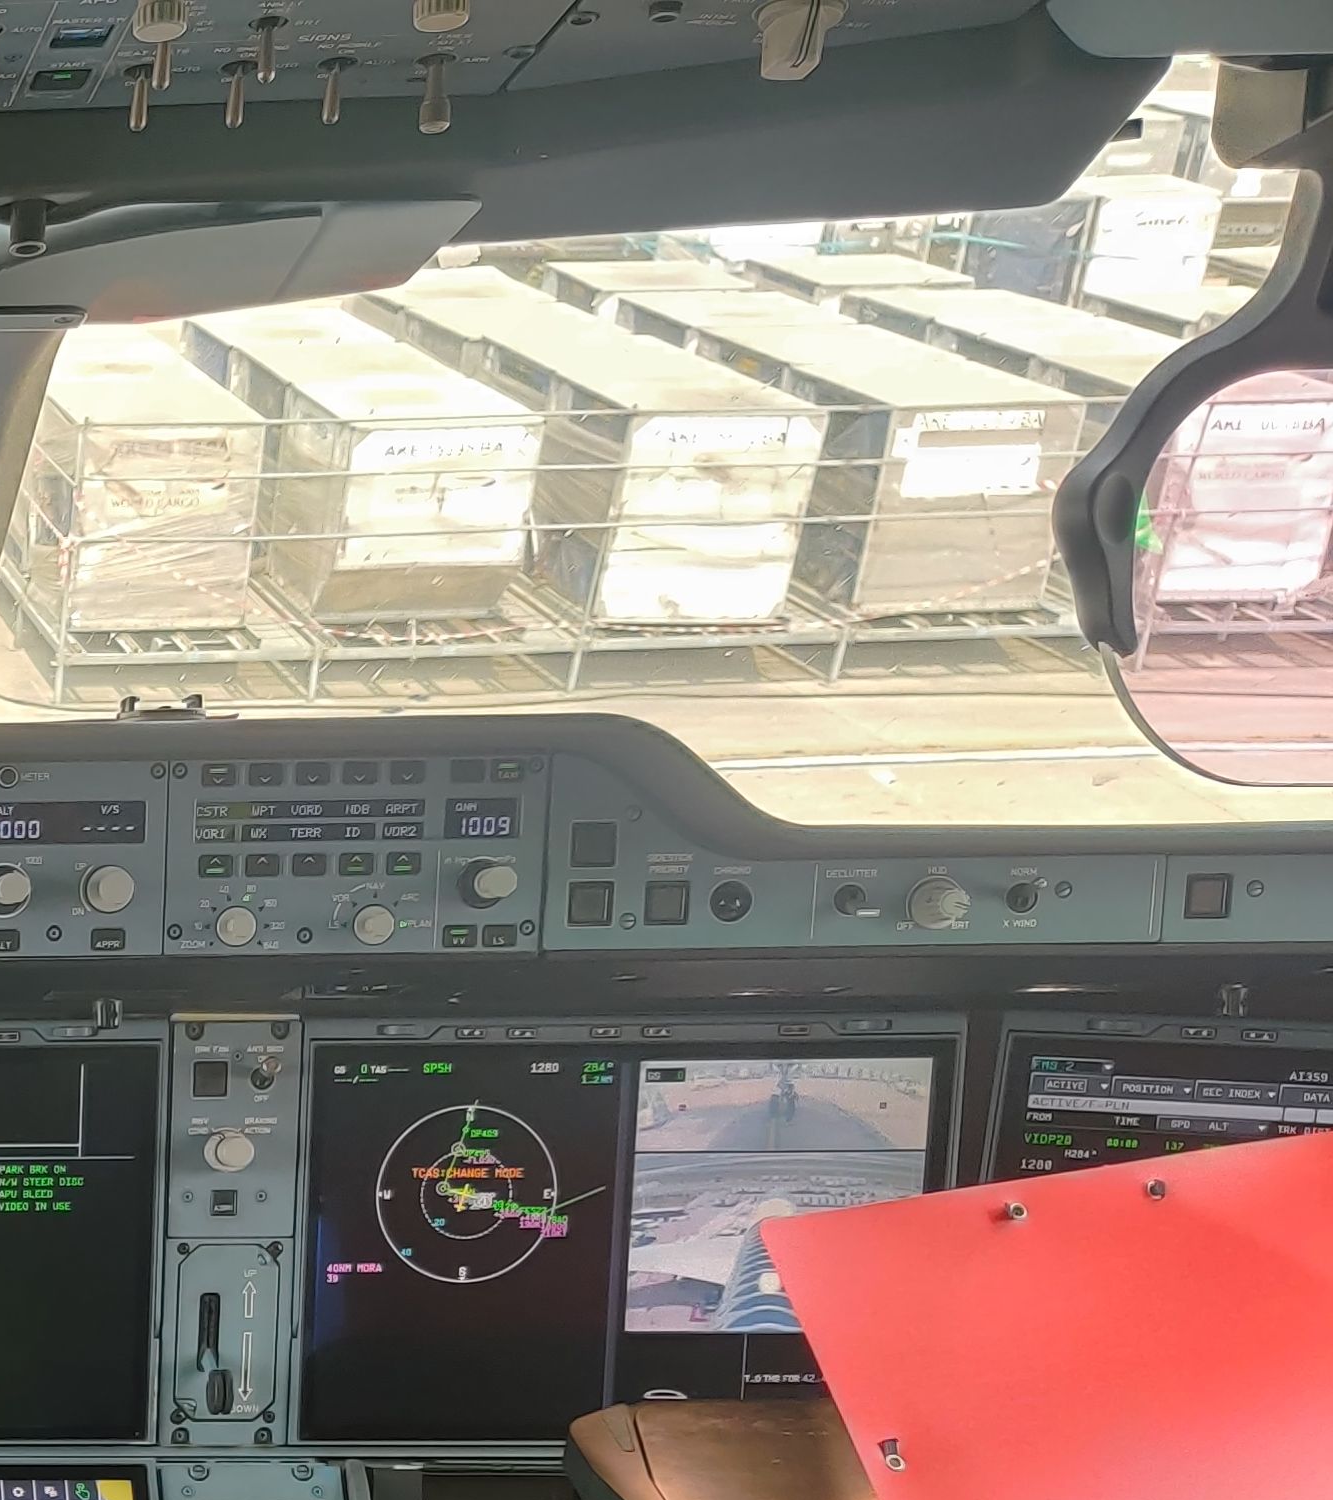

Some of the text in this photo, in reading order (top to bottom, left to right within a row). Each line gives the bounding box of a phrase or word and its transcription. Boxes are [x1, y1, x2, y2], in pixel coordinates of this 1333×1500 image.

[100, 804, 120, 815] V/S
[197, 805, 228, 817] CSTR
[252, 805, 276, 816] WPT
[345, 804, 370, 815] NDB
[385, 803, 417, 814] ARPT
[460, 817, 510, 835] 1009
[195, 826, 417, 840] VOR1 WX TERR ID VOR2
[714, 865, 752, 875] CHRONO
[825, 868, 878, 879] DECLUTTER
[1009, 866, 1038, 877] NORM
[96, 939, 120, 948] APPR
[531, 1062, 559, 1073] 1280
[1289, 1071, 1328, 1082] AI359
[1047, 1080, 1084, 1091] ACTIVE
[1122, 1084, 1174, 1094] POSITION
[1229, 1088, 1261, 1099] INDEX
[1303, 1092, 1330, 1102] DATA
[1026, 1112, 1052, 1122] FROM
[1114, 1117, 1140, 1126] TIME
[0, 1164, 66, 1174] PARK BRK ON
[495, 1168, 525, 1178] MODE
[22, 1189, 53, 1199] BLEED
[35, 1202, 47, 1211] IN
[53, 1201, 71, 1211] USE
